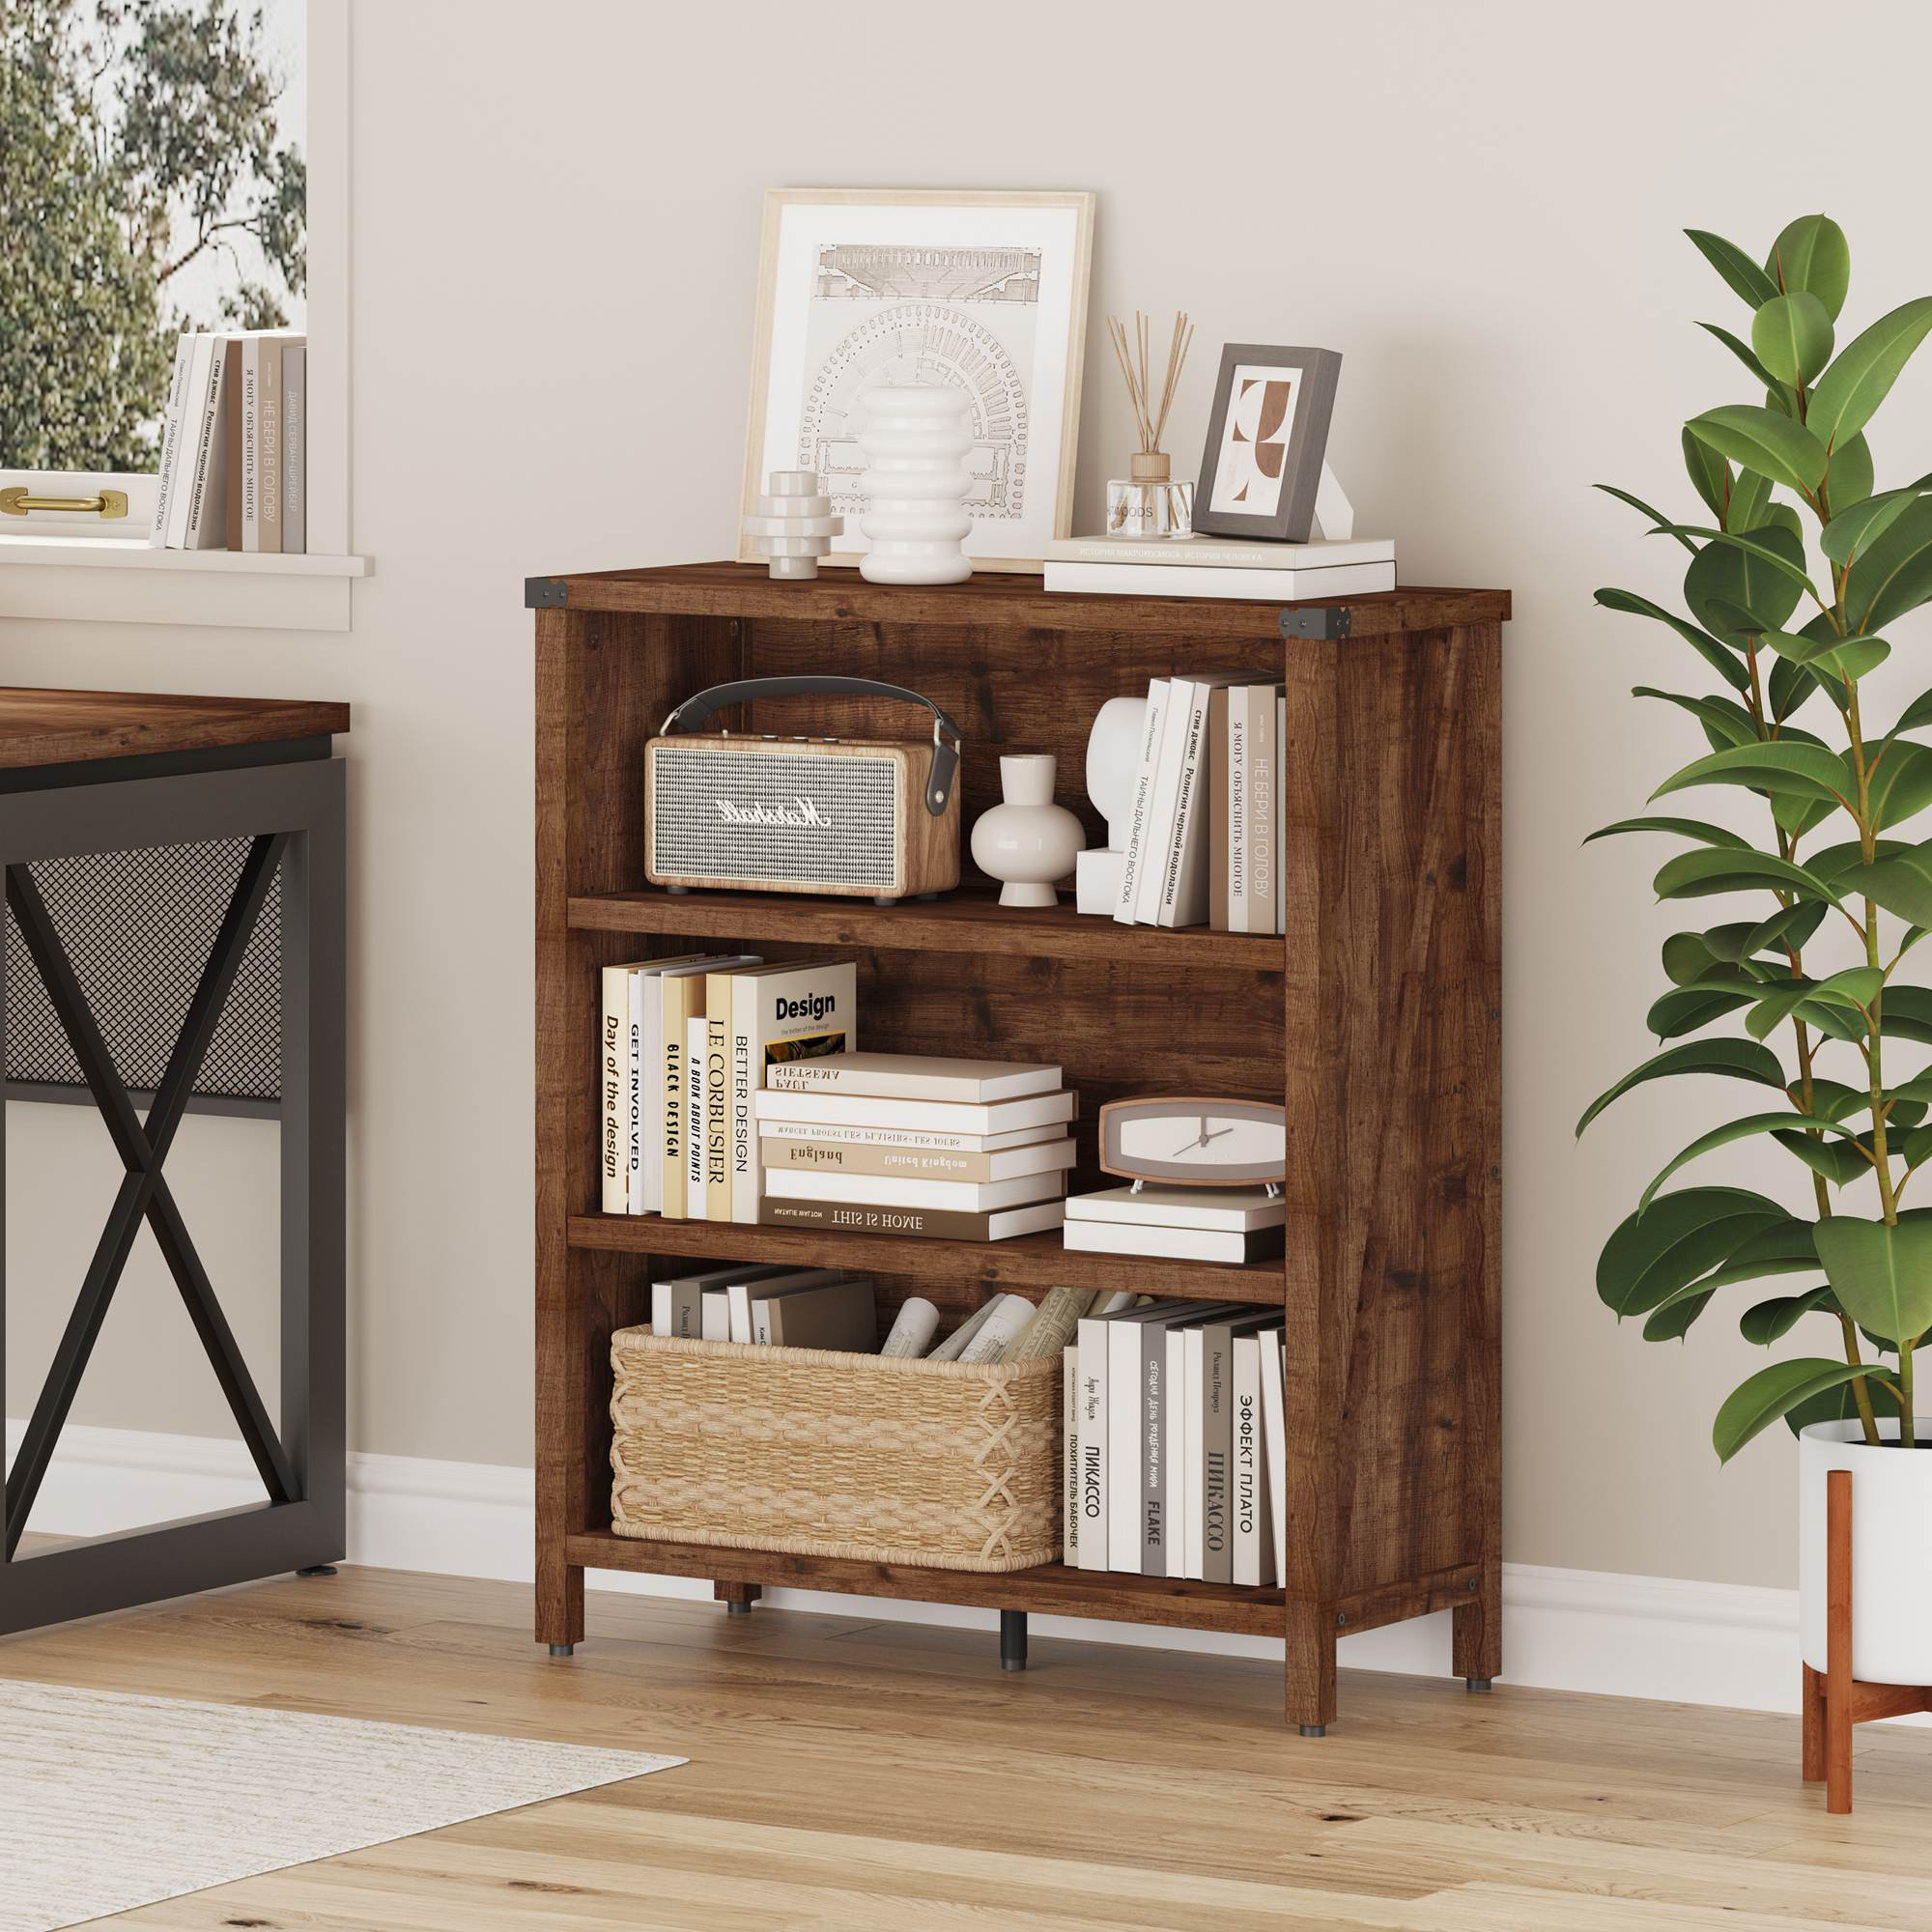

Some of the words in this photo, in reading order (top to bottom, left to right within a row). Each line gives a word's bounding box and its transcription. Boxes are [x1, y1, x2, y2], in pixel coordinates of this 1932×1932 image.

[263, 400, 275, 416] НЕ
[287, 390, 298, 423] ДАВИД
[203, 411, 214, 447] Религия
[263, 420, 275, 454] БЕРИ
[197, 449, 208, 482] черной
[263, 457, 275, 466] В
[156, 492, 167, 531] ВОСТОКА
[191, 483, 204, 530] водолазки
[263, 469, 275, 523] ГОЛОВУ
[1234, 733, 1242, 766] МОГУ
[1254, 758, 1268, 777] НЕ
[1179, 767, 1194, 810] Религия
[1234, 771, 1242, 843] ОБЪЯСНИТЬ
[1254, 781, 1268, 819] БЕРИ
[1128, 809, 1143, 859] ДАЛЬНЕГО
[1174, 811, 1186, 848] черной
[1254, 824, 1268, 835] В
[1122, 860, 1135, 904] ВОСТОКА
[1165, 850, 1179, 905] водолазки
[1234, 846, 1242, 897] МНОГОЕ
[1254, 838, 1268, 898] ГОЛОВУ
[776, 993, 836, 1021] Design
[607, 1016, 618, 1051] Day
[631, 1024, 639, 1062] GET
[709, 1020, 724, 1047] LE
[607, 1056, 618, 1077] of
[667, 1044, 679, 1092] BLACK
[691, 1068, 700, 1099] BOOK
[735, 1036, 748, 1099] BETTER
[607, 1081, 619, 1110] the
[631, 1068, 639, 1171] INVOLVED
[666, 1102, 679, 1157] DESIGN
[691, 1104, 700, 1139] ABOUT
[709, 1054, 724, 1184] CORBUSIER
[735, 1106, 748, 1172] DESIGN
[607, 1114, 619, 1179] design
[691, 1144, 700, 1182] POINTS
[1212, 1351, 1222, 1379] Роланд
[1148, 1397, 1159, 1421] ДЕНЬ
[1148, 1422, 1159, 1464] РОЖДЕНИЯ
[1239, 1394, 1253, 1468] ЭФФЕКТ
[1069, 1435, 1078, 1500] ПОХИТИТЕЛЬ
[1085, 1446, 1100, 1519] ПИКАССО
[1149, 1464, 1158, 1488] МИРА
[1208, 1451, 1225, 1551] ПИКАССО
[1239, 1473, 1253, 1534] ПЛАТО
[1069, 1502, 1078, 1548] БАБОЧЕК
[1148, 1500, 1160, 1546] FLAKE
